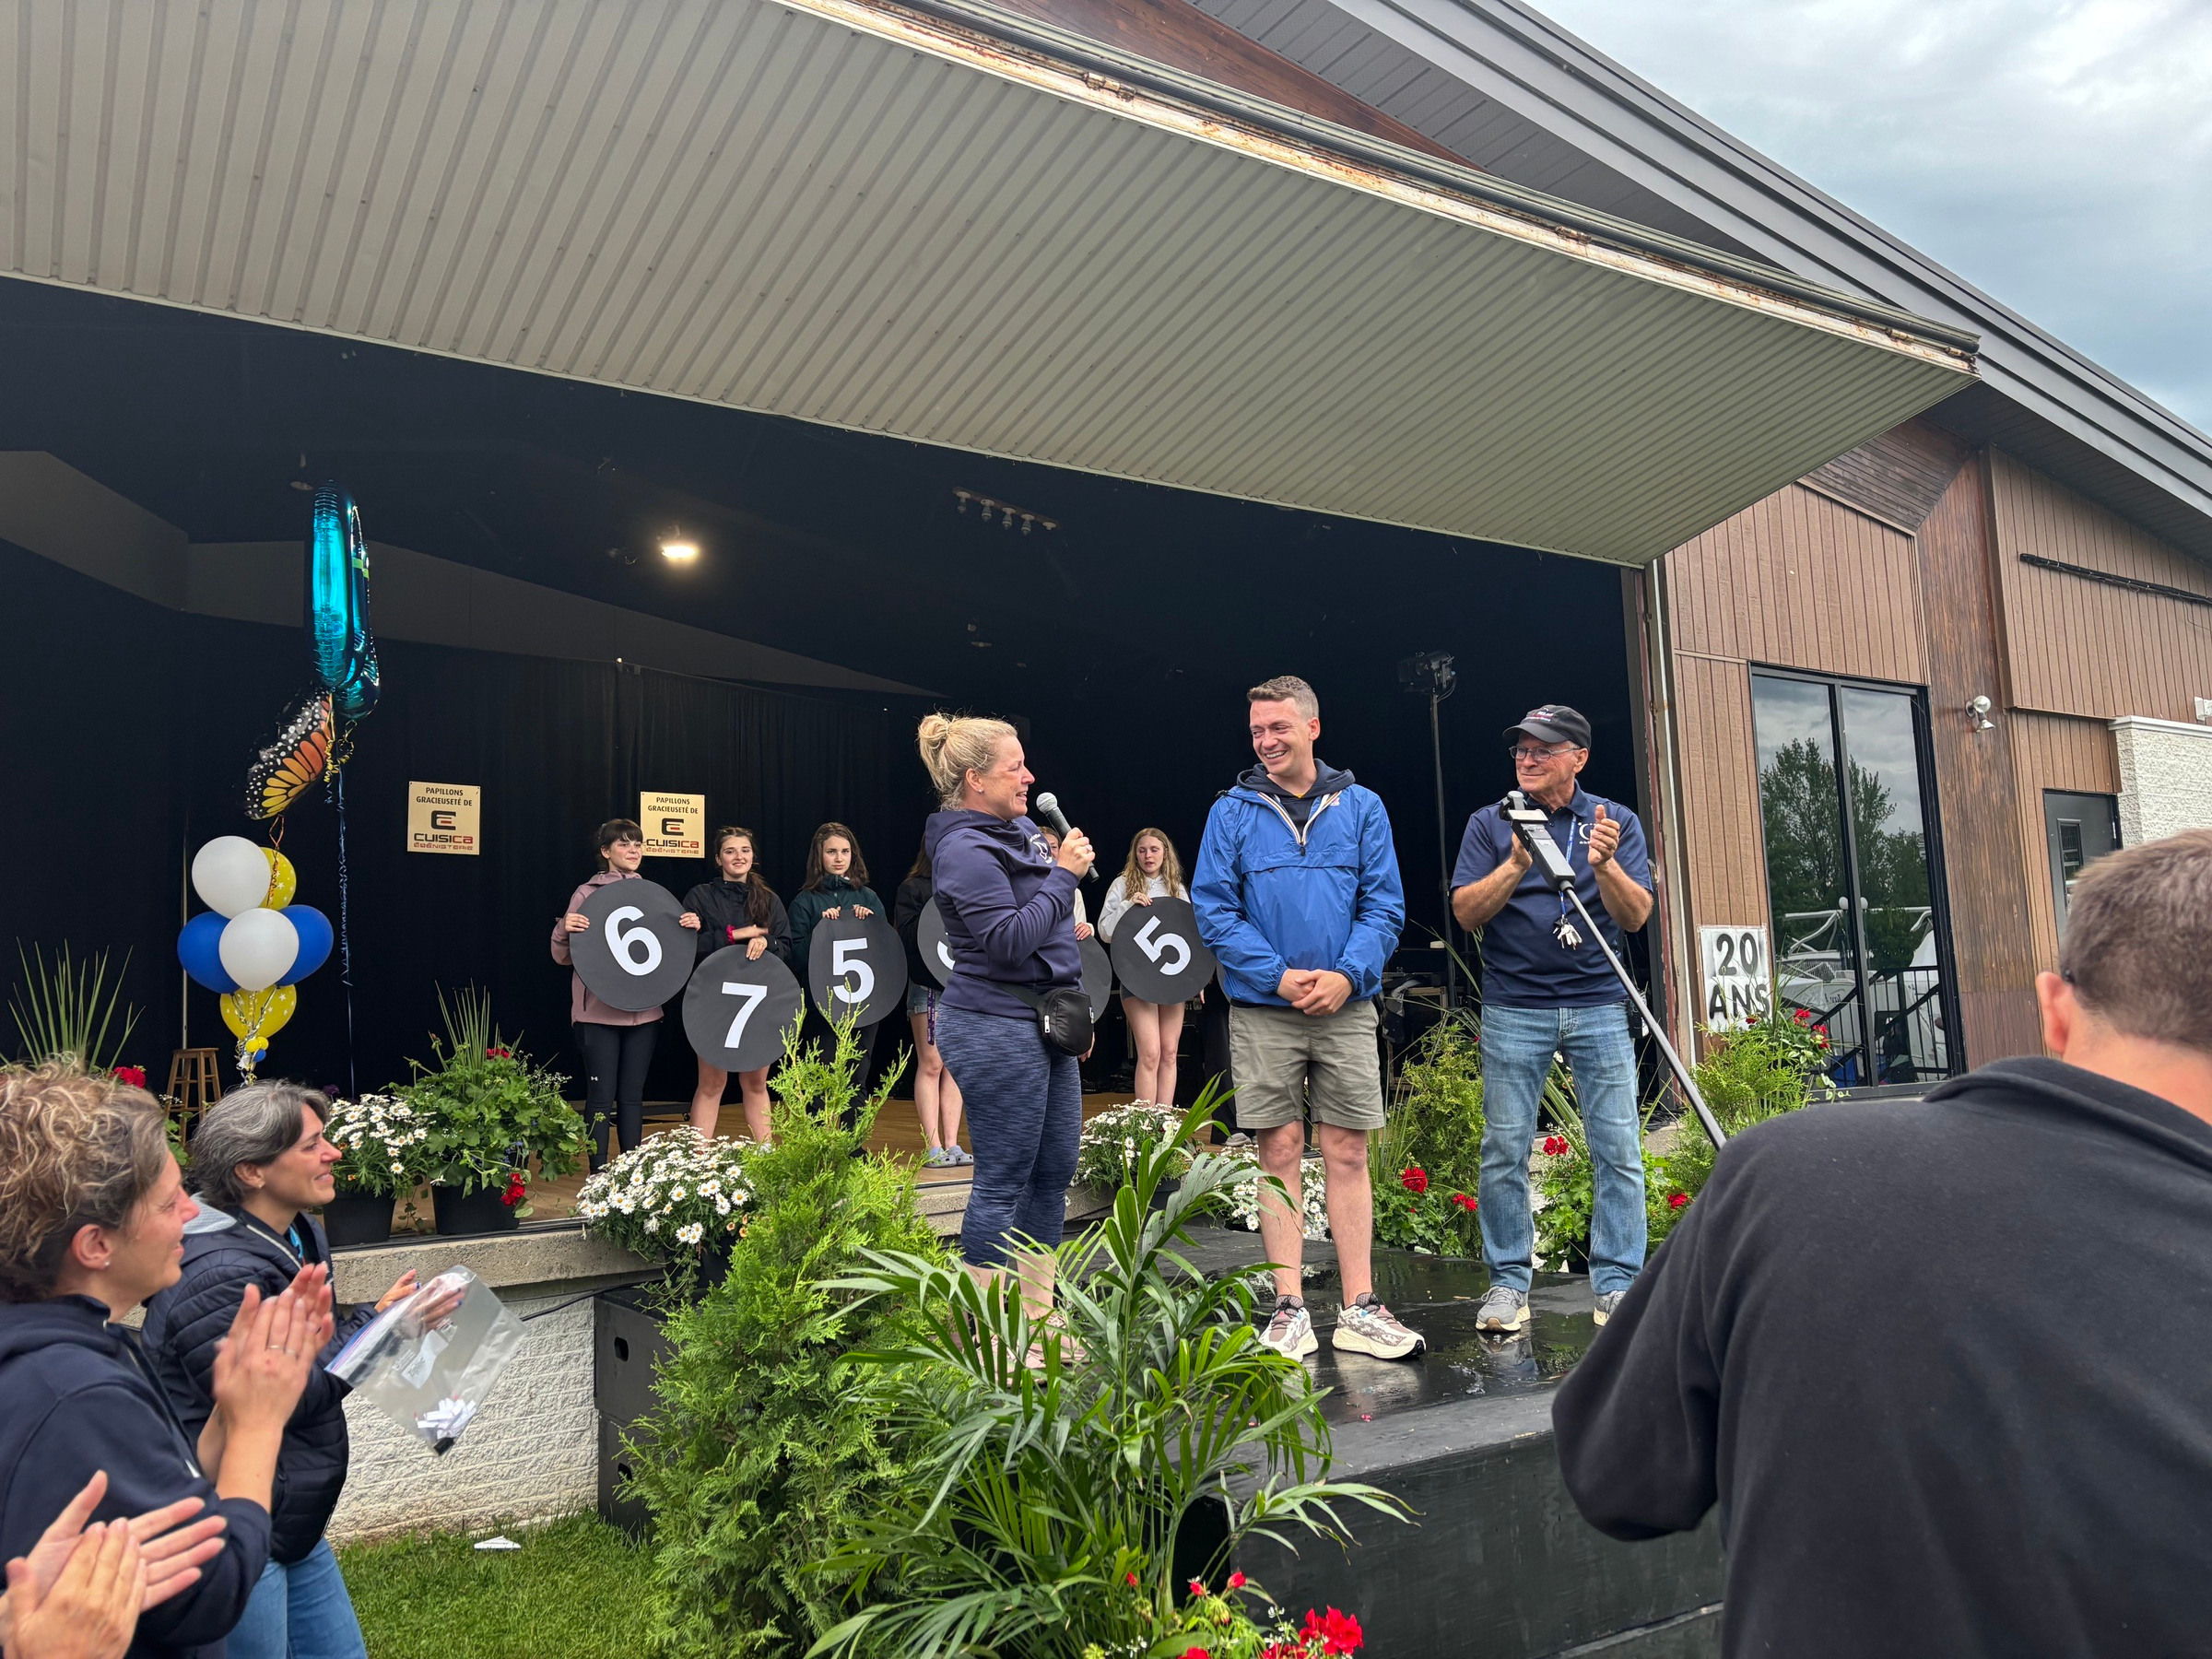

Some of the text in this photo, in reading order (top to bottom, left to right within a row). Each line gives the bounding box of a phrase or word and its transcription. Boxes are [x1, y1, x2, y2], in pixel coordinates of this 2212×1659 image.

[416, 796, 461, 806] GRACIEUSETÉ
[425, 787, 464, 796] PAPILLONS
[647, 805, 688, 814] GRACIEUSETÉ
[656, 796, 690, 805] PAPILLONS
[605, 905, 663, 976] 6
[1133, 914, 1192, 976] 5
[1716, 932, 1759, 976] 20
[832, 937, 875, 1004] 5
[721, 982, 768, 1049] 7
[1709, 983, 1771, 1019] ANS
